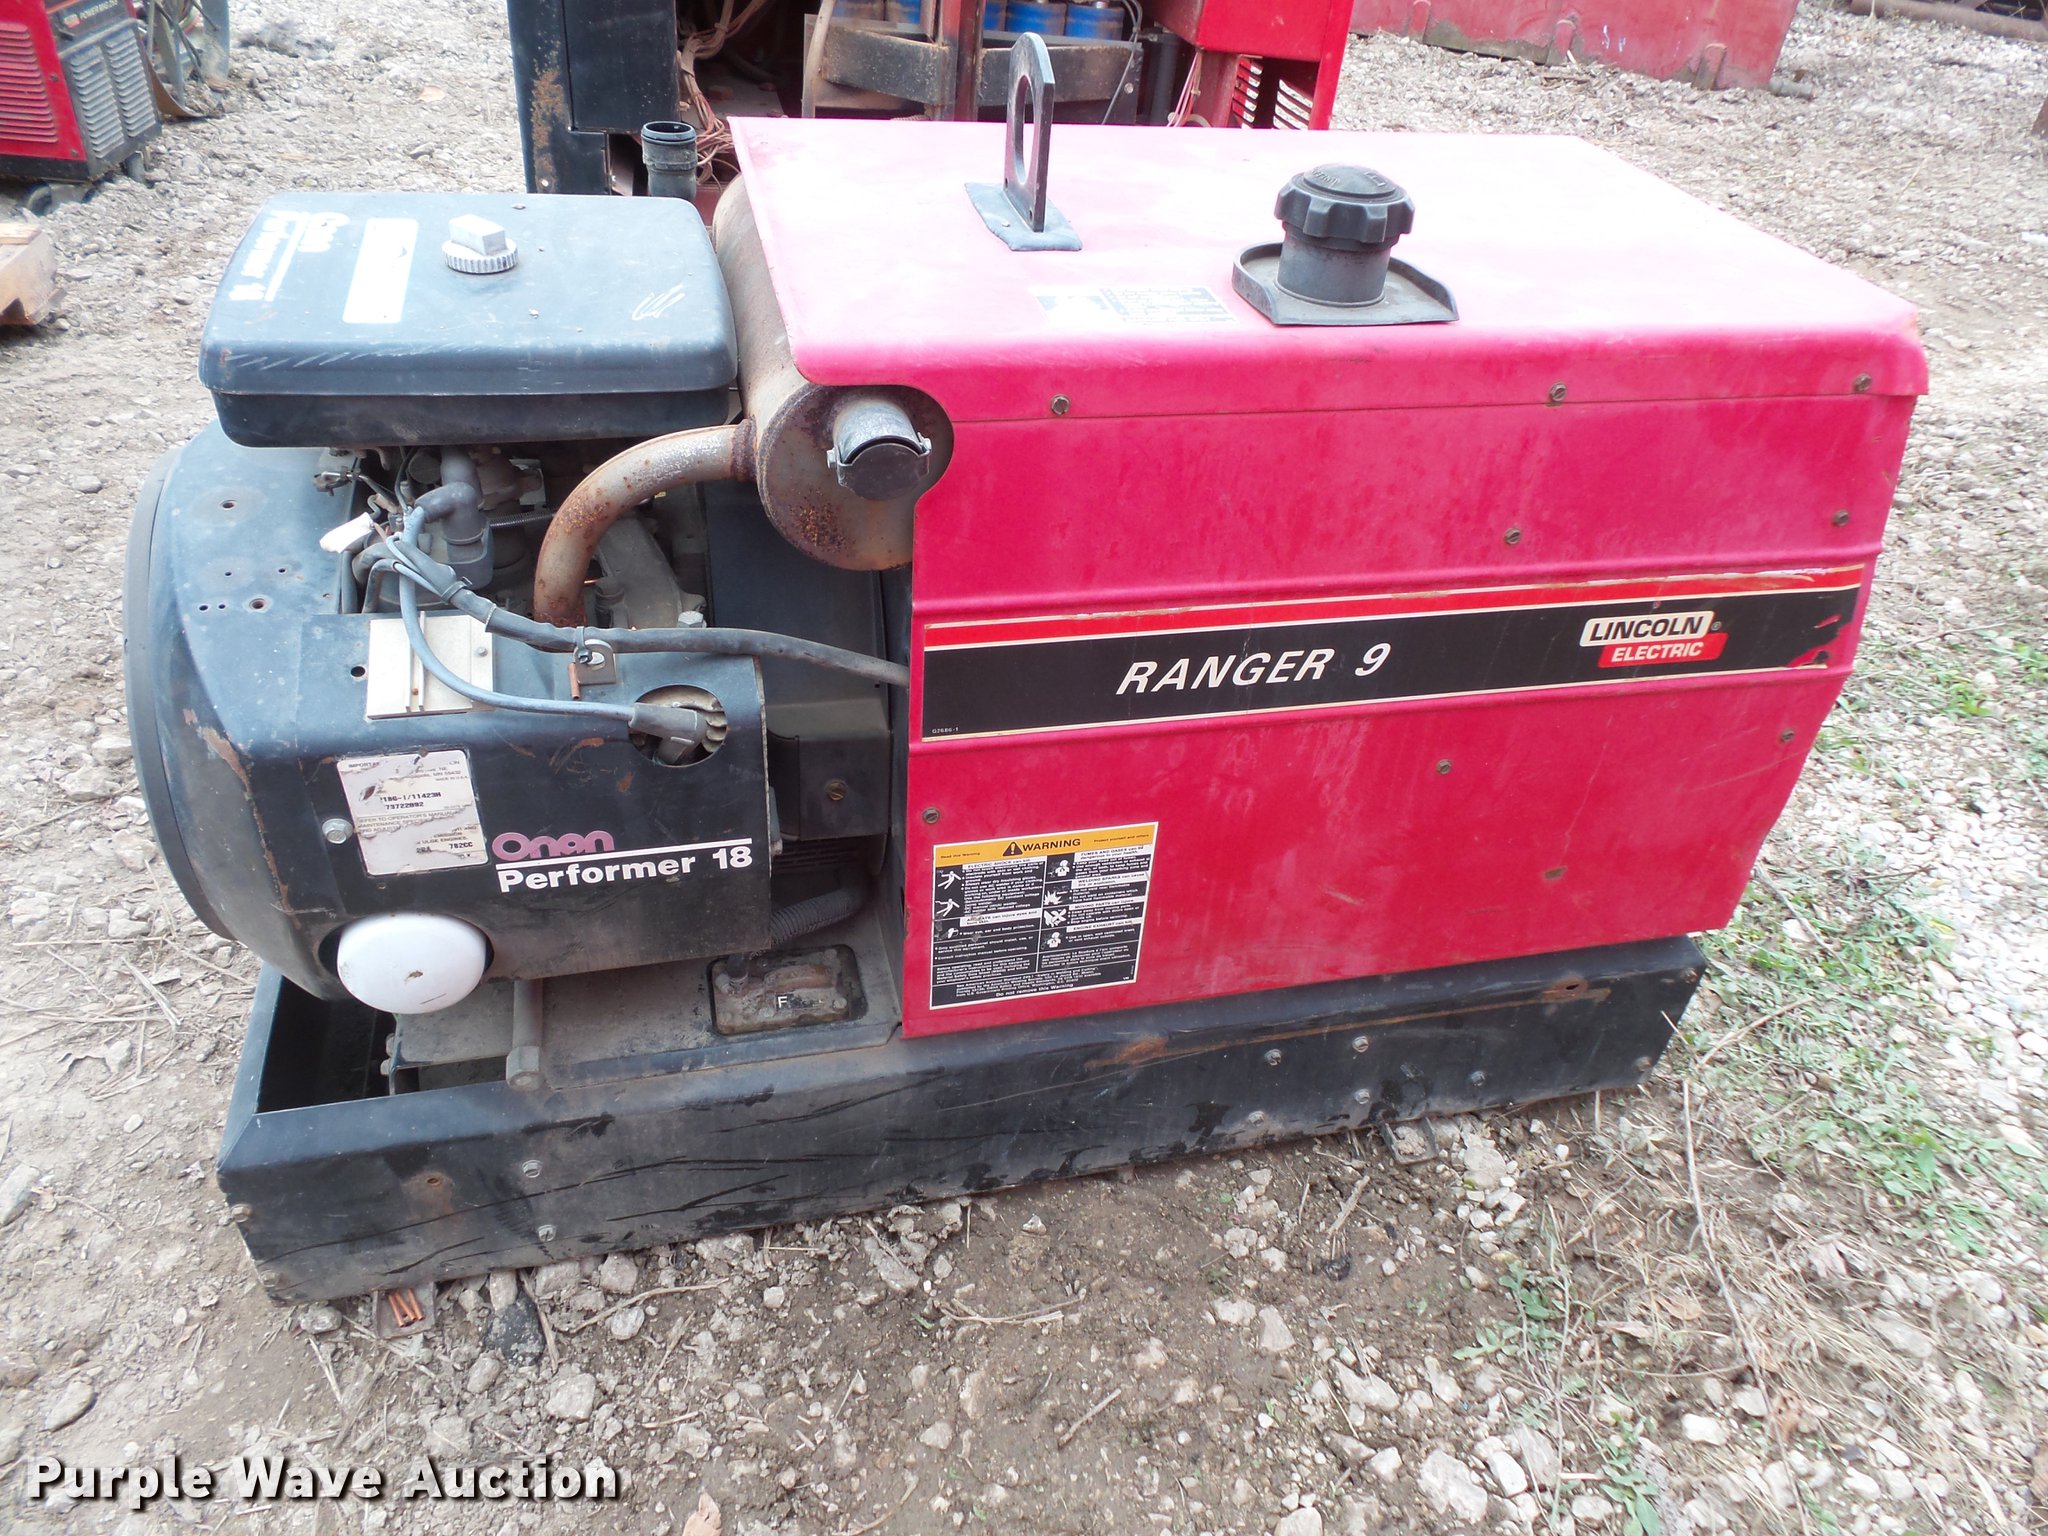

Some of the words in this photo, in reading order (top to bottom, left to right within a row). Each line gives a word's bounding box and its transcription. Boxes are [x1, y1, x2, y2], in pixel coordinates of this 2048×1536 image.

[1589, 616, 1704, 642] LINCOLN
[1611, 642, 1704, 662] ELECTRIC
[1116, 648, 1335, 696] RANGER
[1355, 642, 1392, 677] 9
[492, 830, 615, 861] Onan
[1023, 839, 1081, 851] WARNING
[498, 856, 695, 893] Performer
[712, 846, 752, 870] 18
